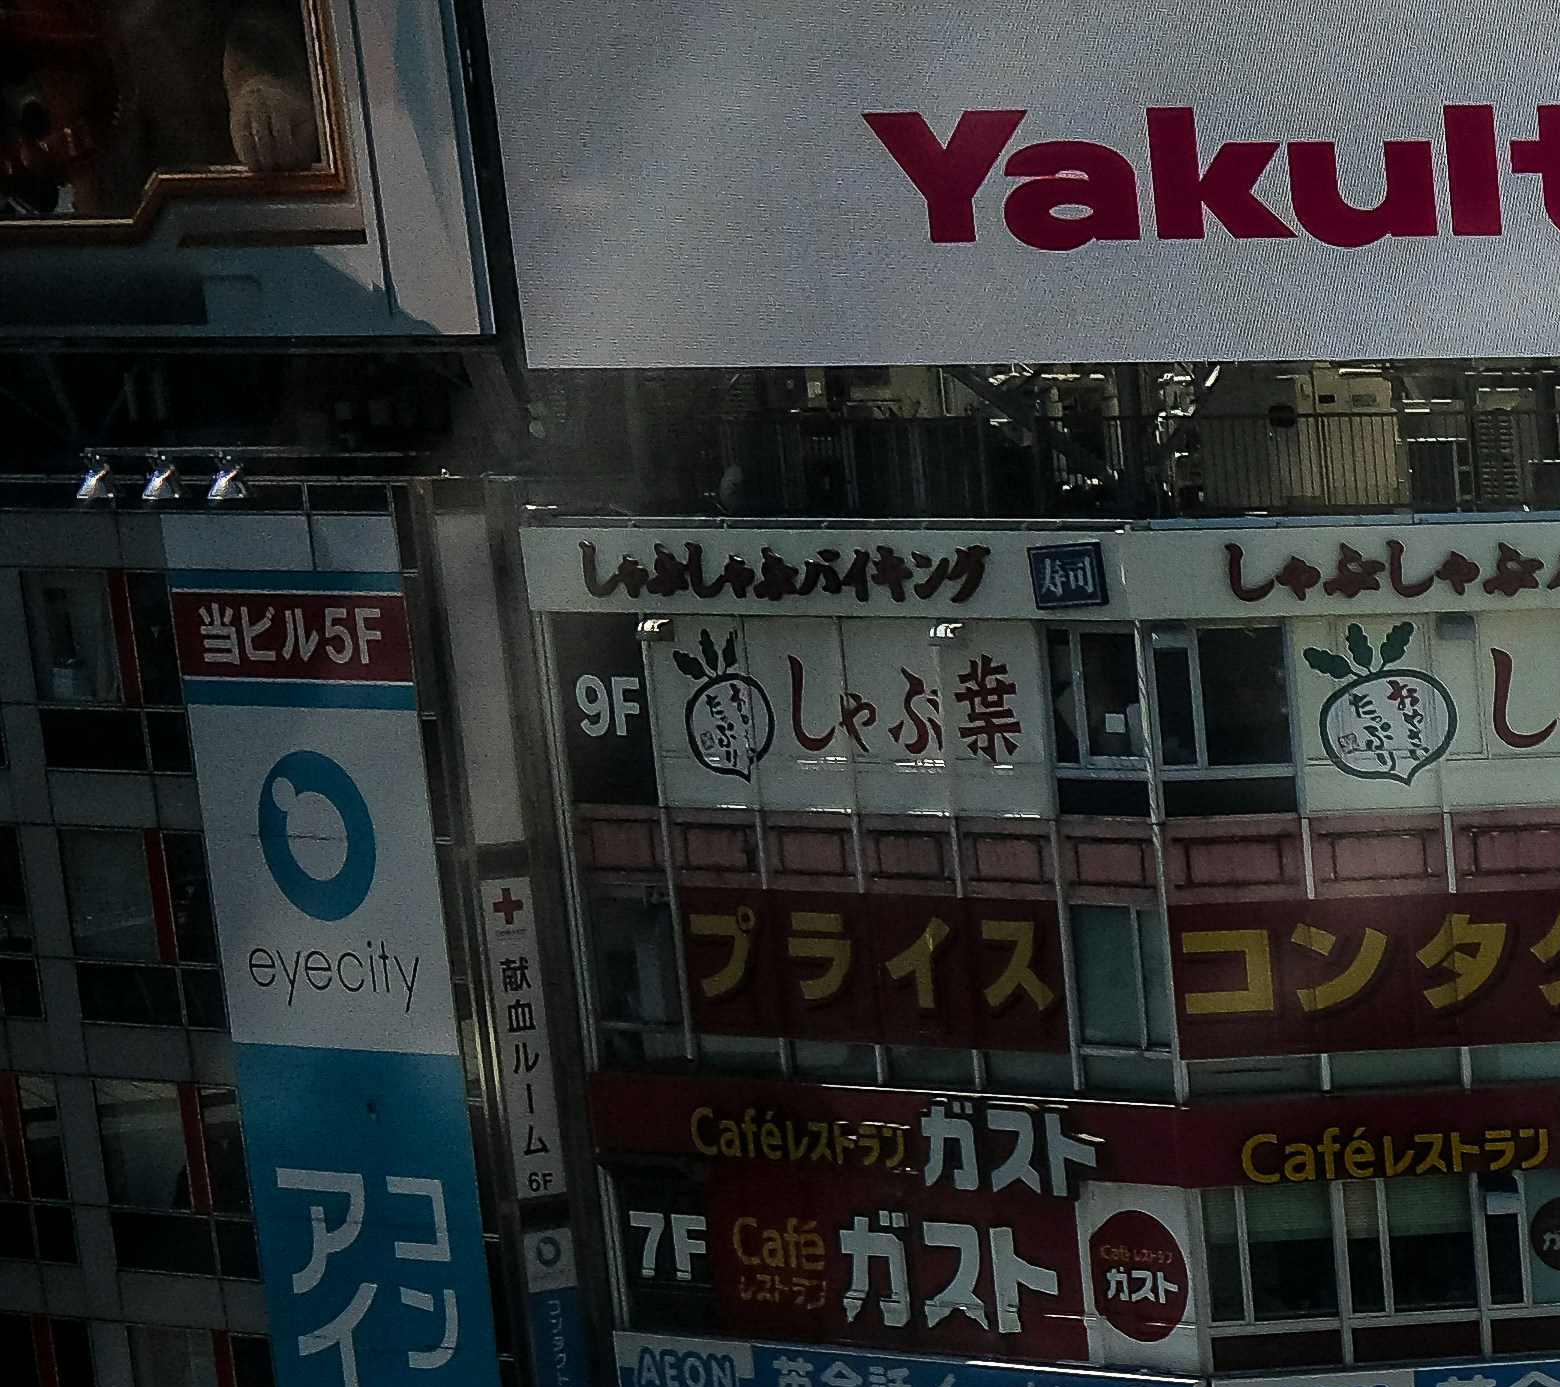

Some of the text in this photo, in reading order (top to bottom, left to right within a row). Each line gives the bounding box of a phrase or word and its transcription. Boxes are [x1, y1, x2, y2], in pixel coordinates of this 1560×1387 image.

[578, 539, 992, 604] しゃぶしゃぶバイキング
[1037, 556, 1095, 597] 寿司
[198, 601, 383, 666] 当ビル5F
[575, 675, 641, 738] 9F
[786, 652, 1023, 762] しゃぶ葉
[247, 940, 420, 1013] eyecity
[688, 907, 1057, 1013] プライス
[499, 956, 552, 1158] 献血ルーム
[527, 1171, 554, 1194] 6F
[921, 1100, 1098, 1198] ガスト
[628, 1210, 708, 1281] 7F
[732, 1216, 826, 1272] Café
[839, 1209, 1060, 1335] ガスト
[1105, 1267, 1179, 1305] ガスト
